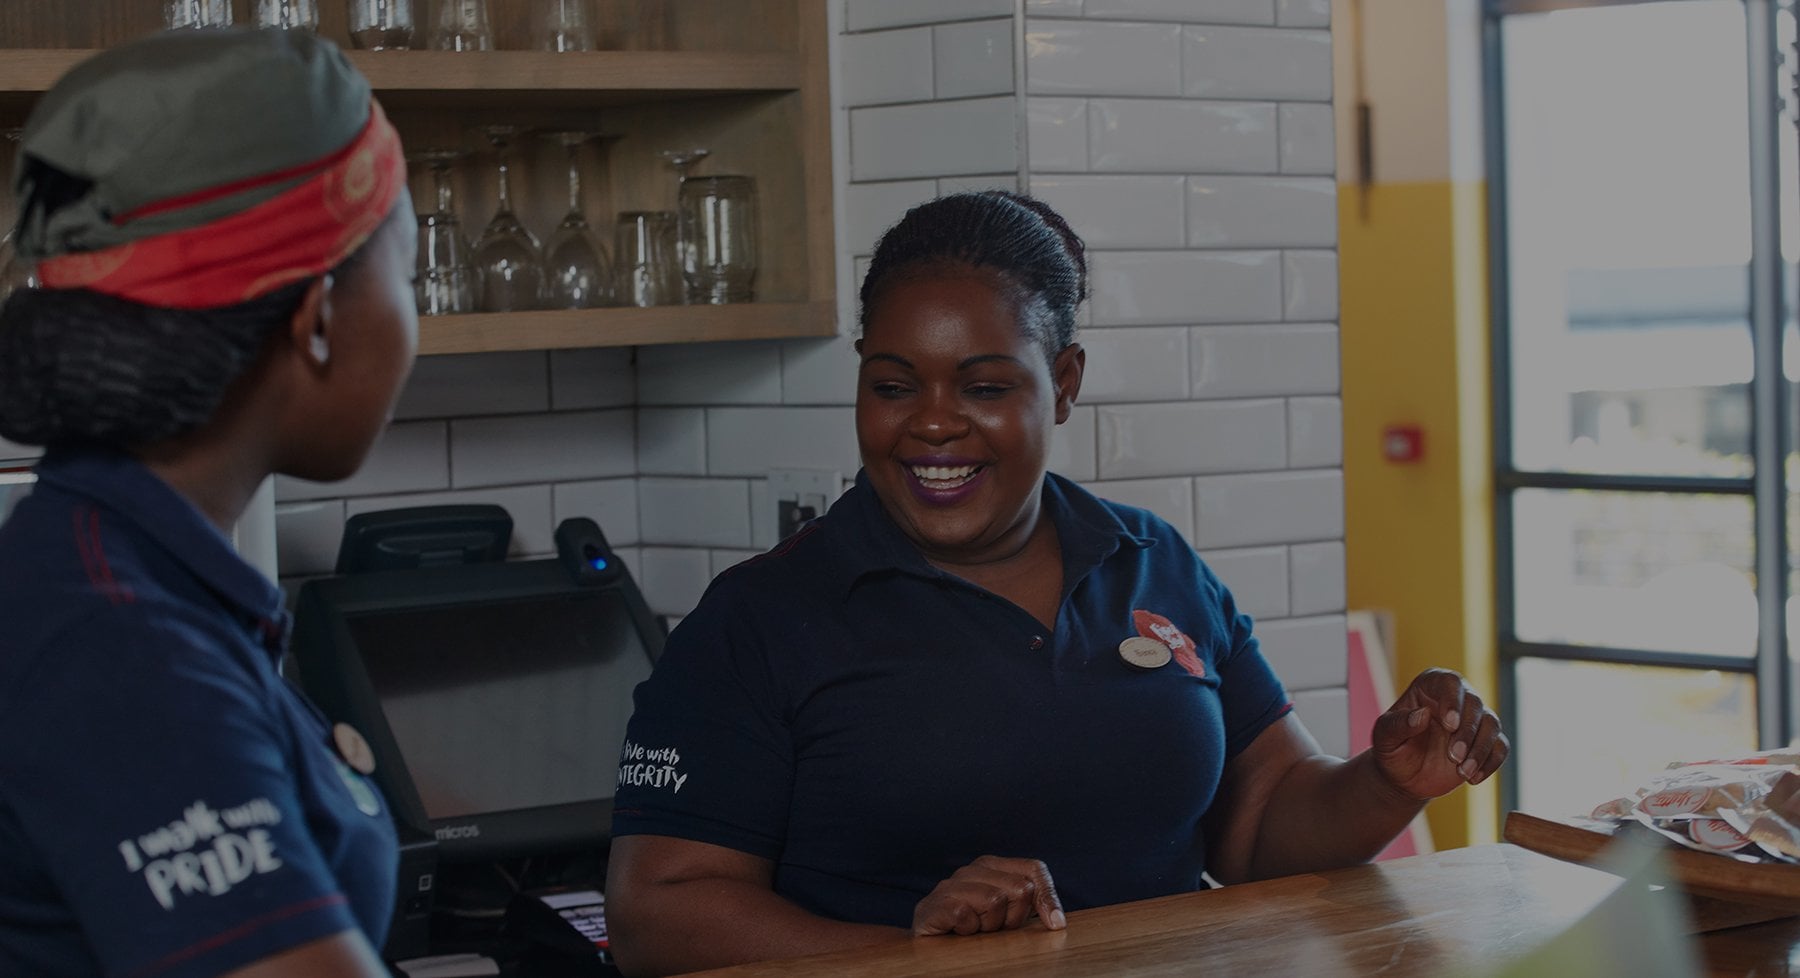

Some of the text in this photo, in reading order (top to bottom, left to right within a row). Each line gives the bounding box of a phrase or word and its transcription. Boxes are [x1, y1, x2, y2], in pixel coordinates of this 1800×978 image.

[646, 747, 680, 765] with
[435, 825, 480, 840] micros
[118, 838, 144, 873] I
[143, 827, 283, 912] PRIDE
